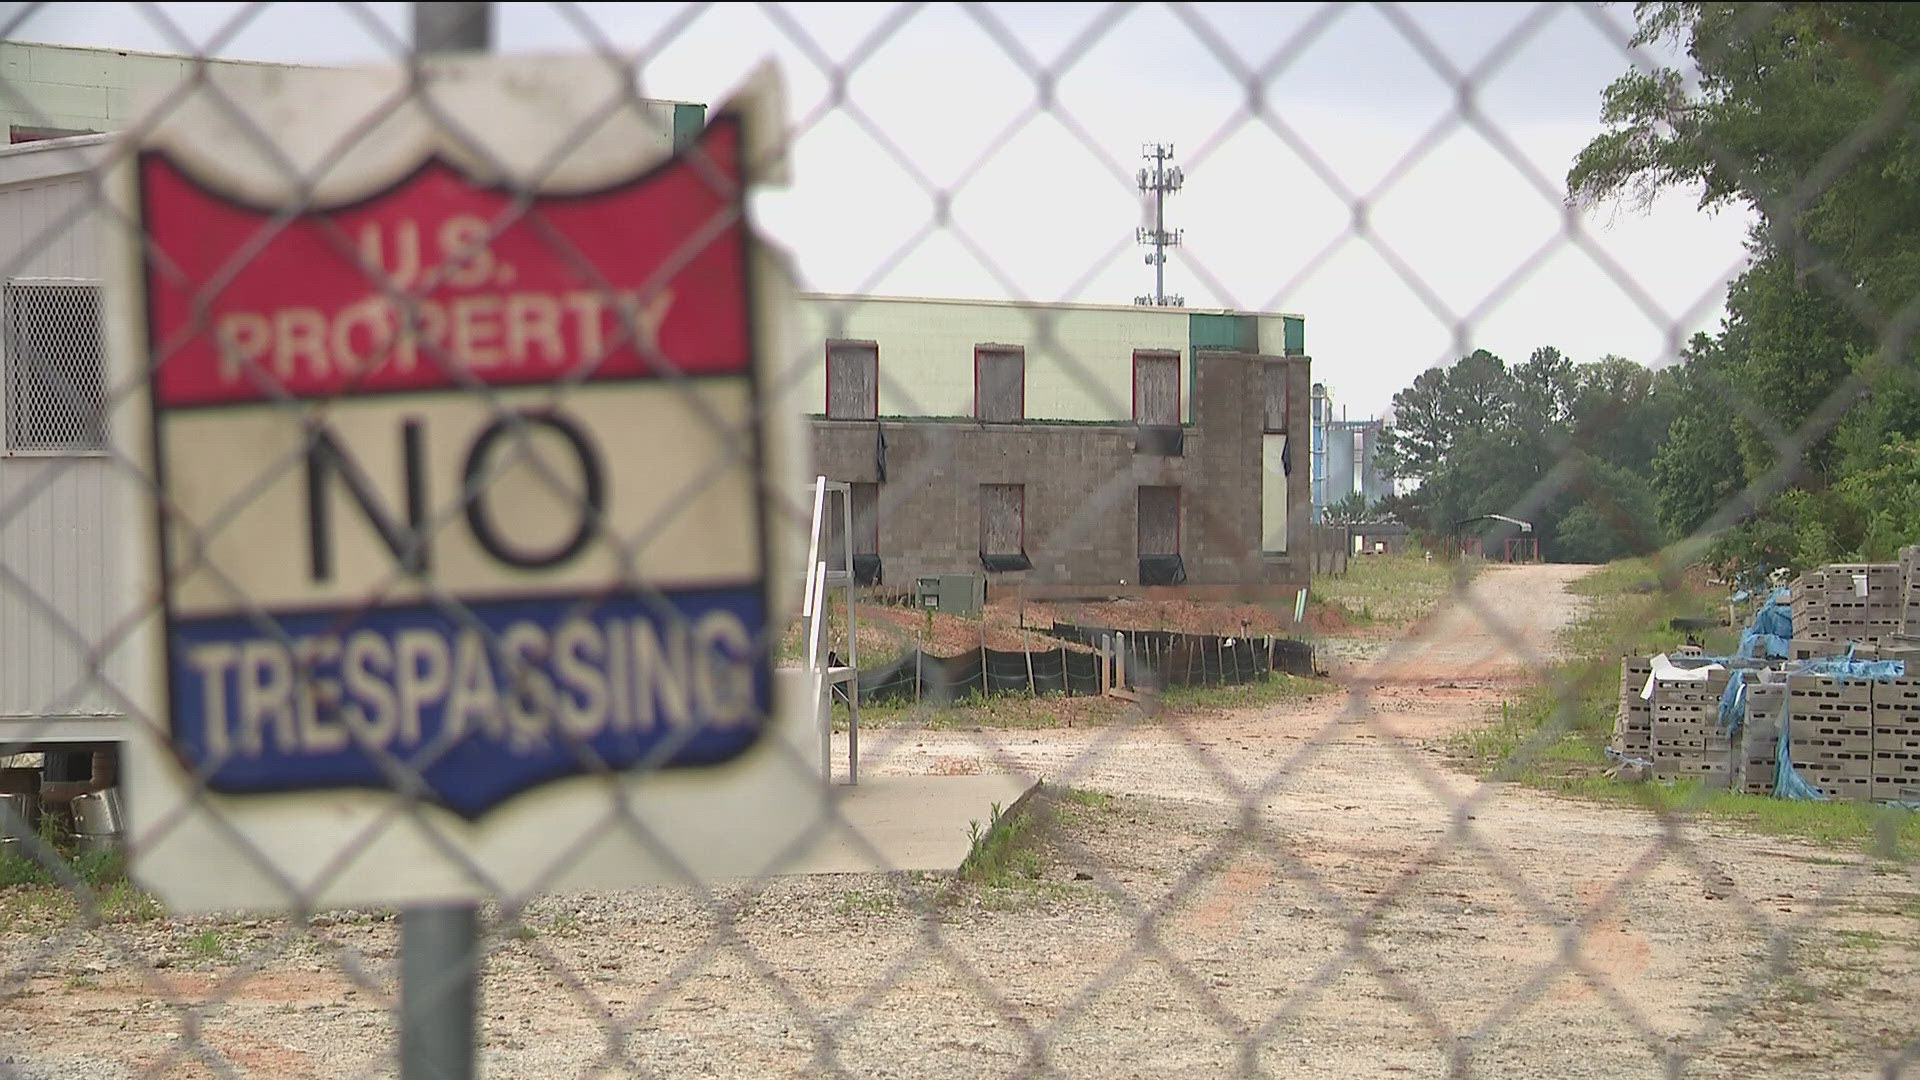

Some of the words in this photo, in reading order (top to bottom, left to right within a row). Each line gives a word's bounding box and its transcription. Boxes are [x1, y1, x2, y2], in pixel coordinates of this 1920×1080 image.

[360, 216, 516, 290] U.S.
[216, 291, 674, 383] PROPERTY
[303, 409, 609, 583] NO
[187, 610, 755, 757] TRESPASSING
